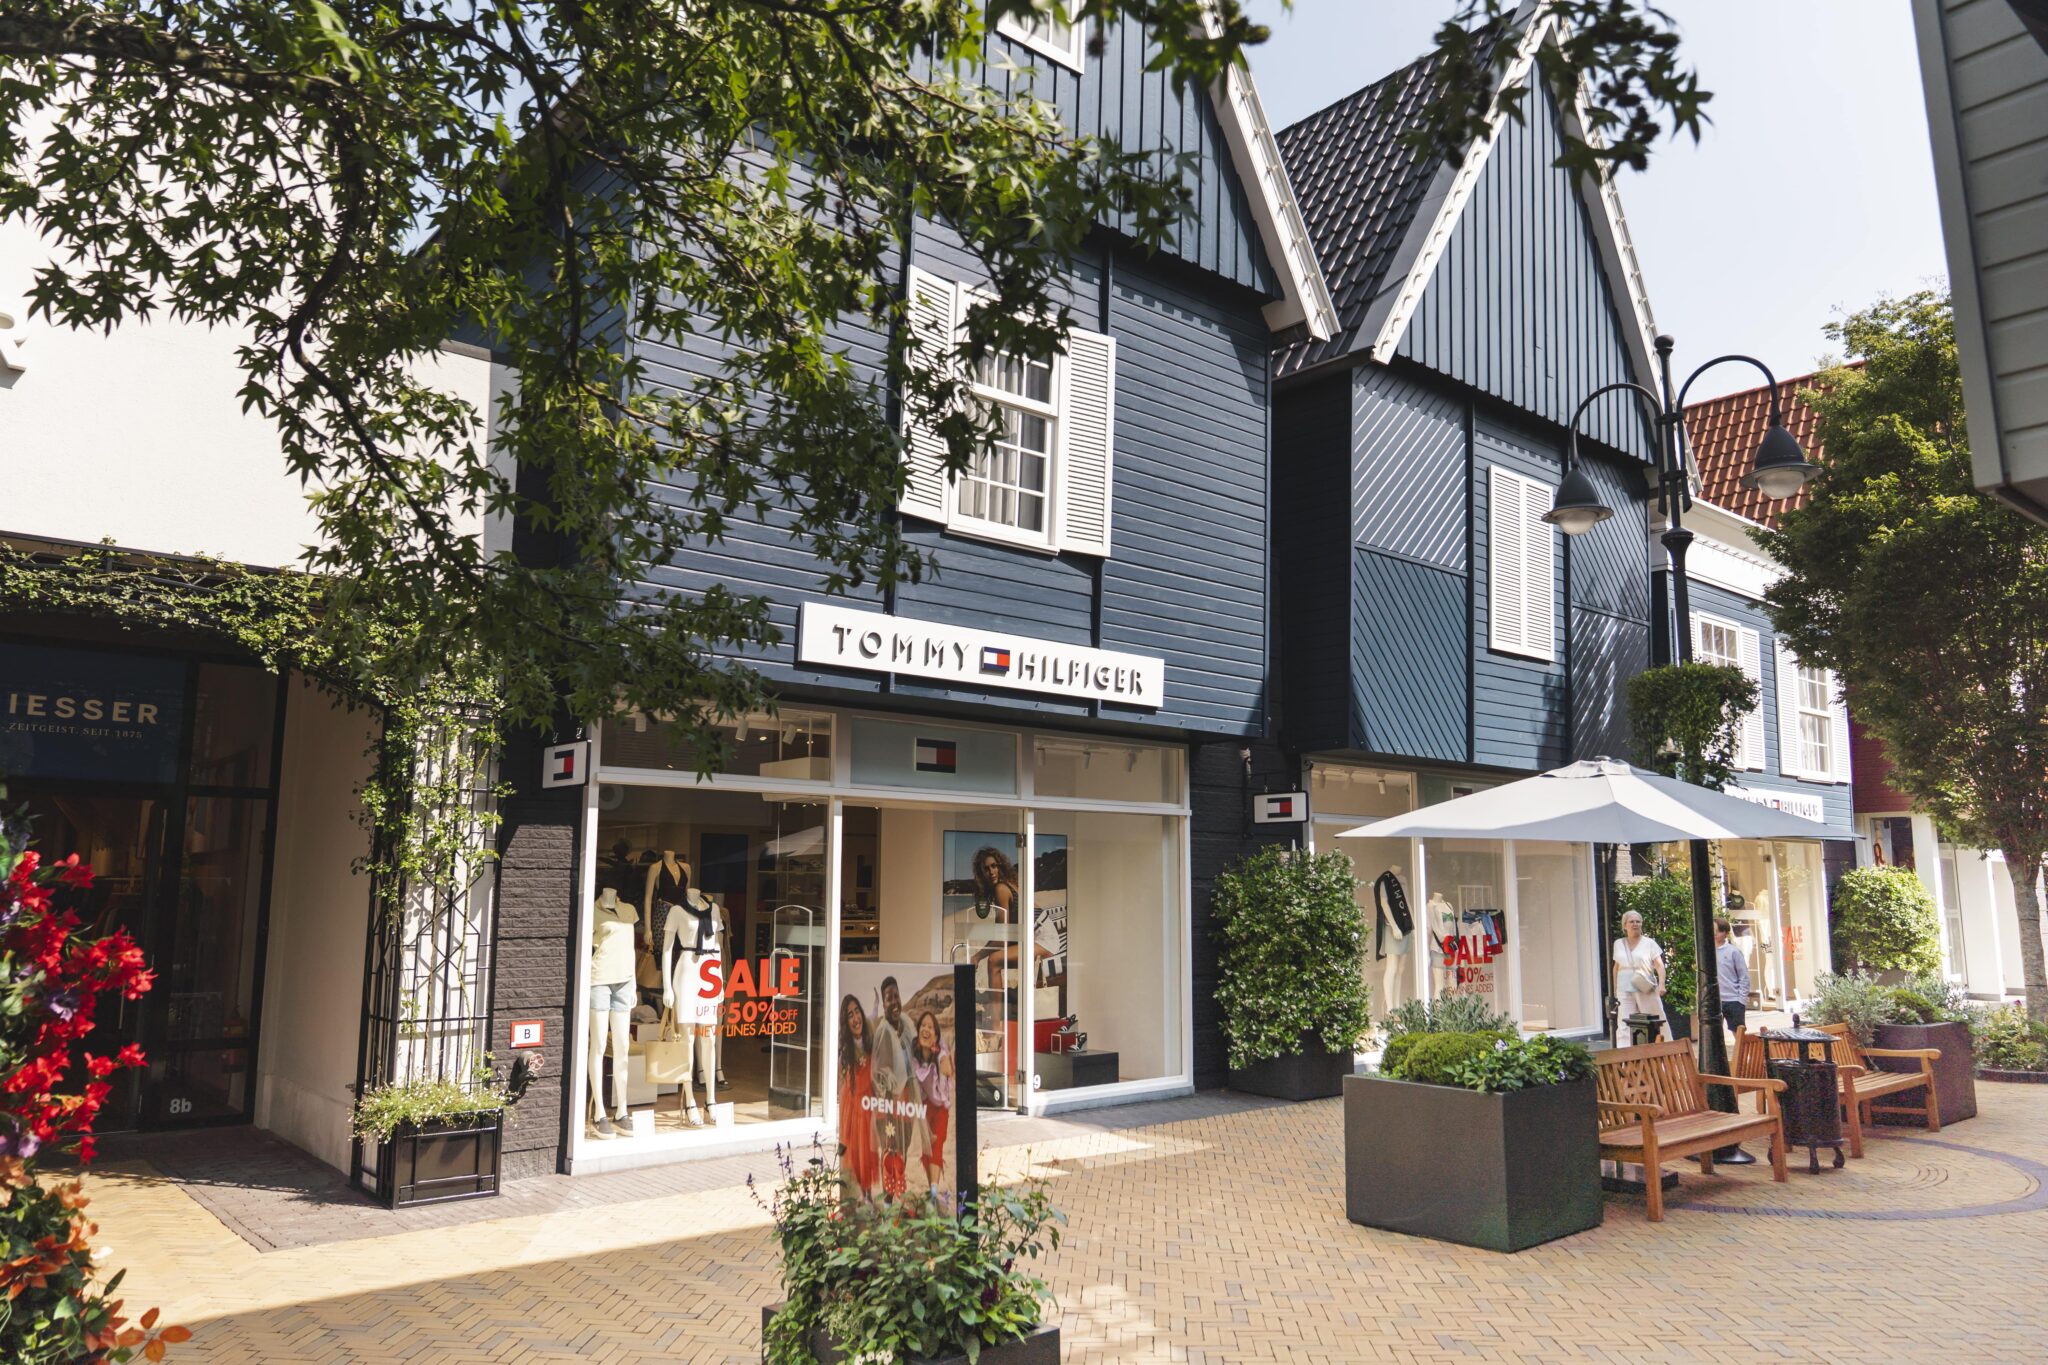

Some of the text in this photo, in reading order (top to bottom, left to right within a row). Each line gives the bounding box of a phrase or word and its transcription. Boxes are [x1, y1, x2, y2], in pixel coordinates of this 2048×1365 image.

[832, 624, 1144, 696] TOMMY HILFIGER
[82, 727, 111, 737] SEIT
[1443, 934, 1493, 967] SALE
[698, 958, 799, 998] SALE
[696, 1000, 798, 1024] UP TO 50% OFF
[524, 1028, 531, 1040] B
[694, 1021, 797, 1038] NEW LINES ADDED
[1033, 1074, 1041, 1090] 9
[169, 1097, 192, 1114] 8b
[861, 1095, 928, 1119] OPEN NOW
